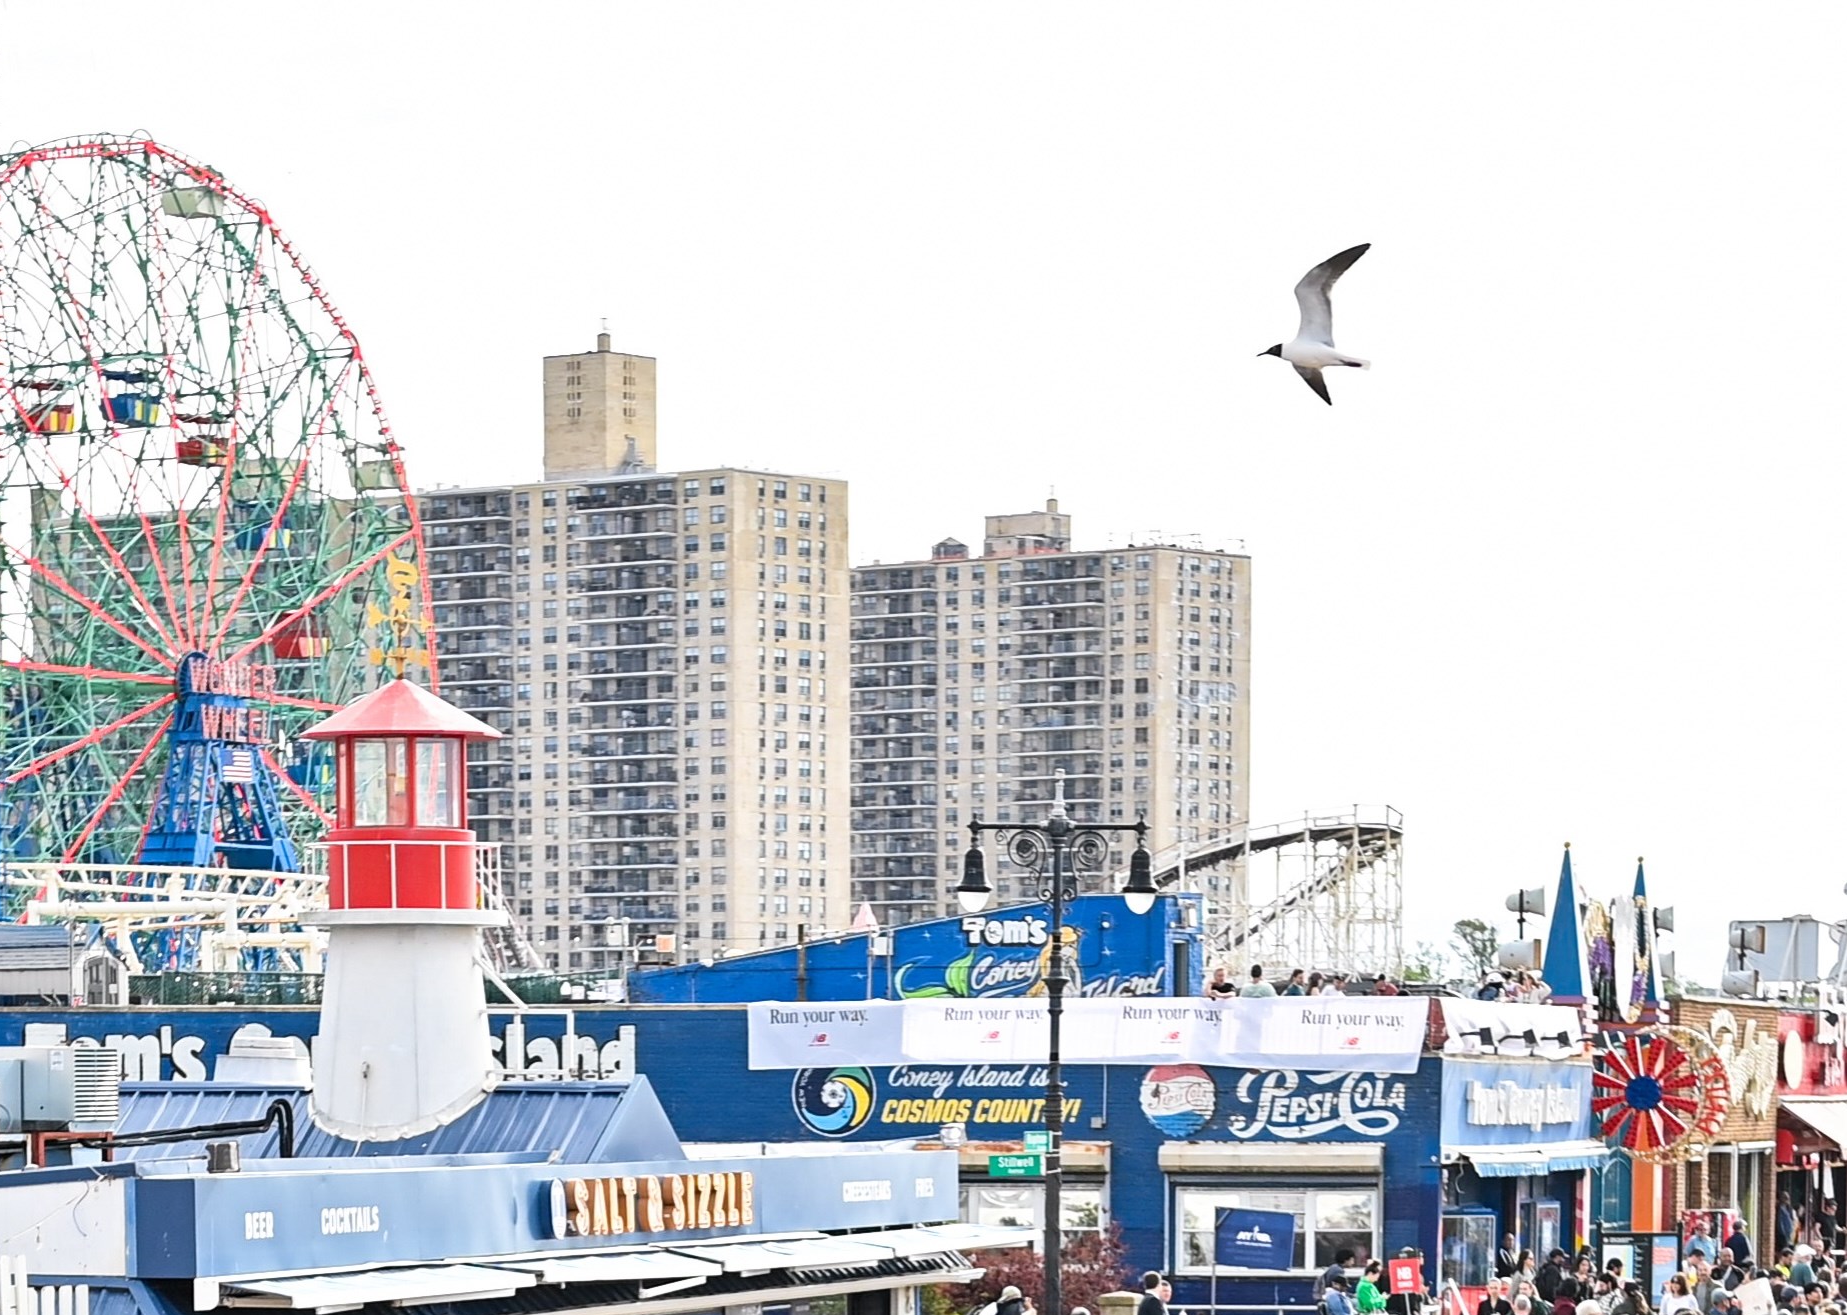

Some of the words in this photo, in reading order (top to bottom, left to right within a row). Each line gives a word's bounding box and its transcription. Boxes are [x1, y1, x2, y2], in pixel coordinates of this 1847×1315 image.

[962, 916, 1047, 945] Tom's
[971, 955, 1041, 990] Coney
[770, 1009, 799, 1024] Run
[802, 1010, 836, 1027] your
[944, 1007, 973, 1021] Run
[977, 1008, 1011, 1024] your
[1122, 1005, 1153, 1020] Run
[1155, 1007, 1190, 1024] your
[1301, 1009, 1331, 1025] Run
[1335, 1012, 1371, 1030] your
[888, 1065, 953, 1098] Coney
[957, 1065, 1026, 1087] Island
[881, 1099, 972, 1123] COSMOS
[974, 1098, 1082, 1123] COUNTY!
[574, 1177, 638, 1236] SALT
[671, 1172, 754, 1230] SIZZLE
[245, 1212, 274, 1239] BEER
[321, 1206, 380, 1235] COCKTAILS
